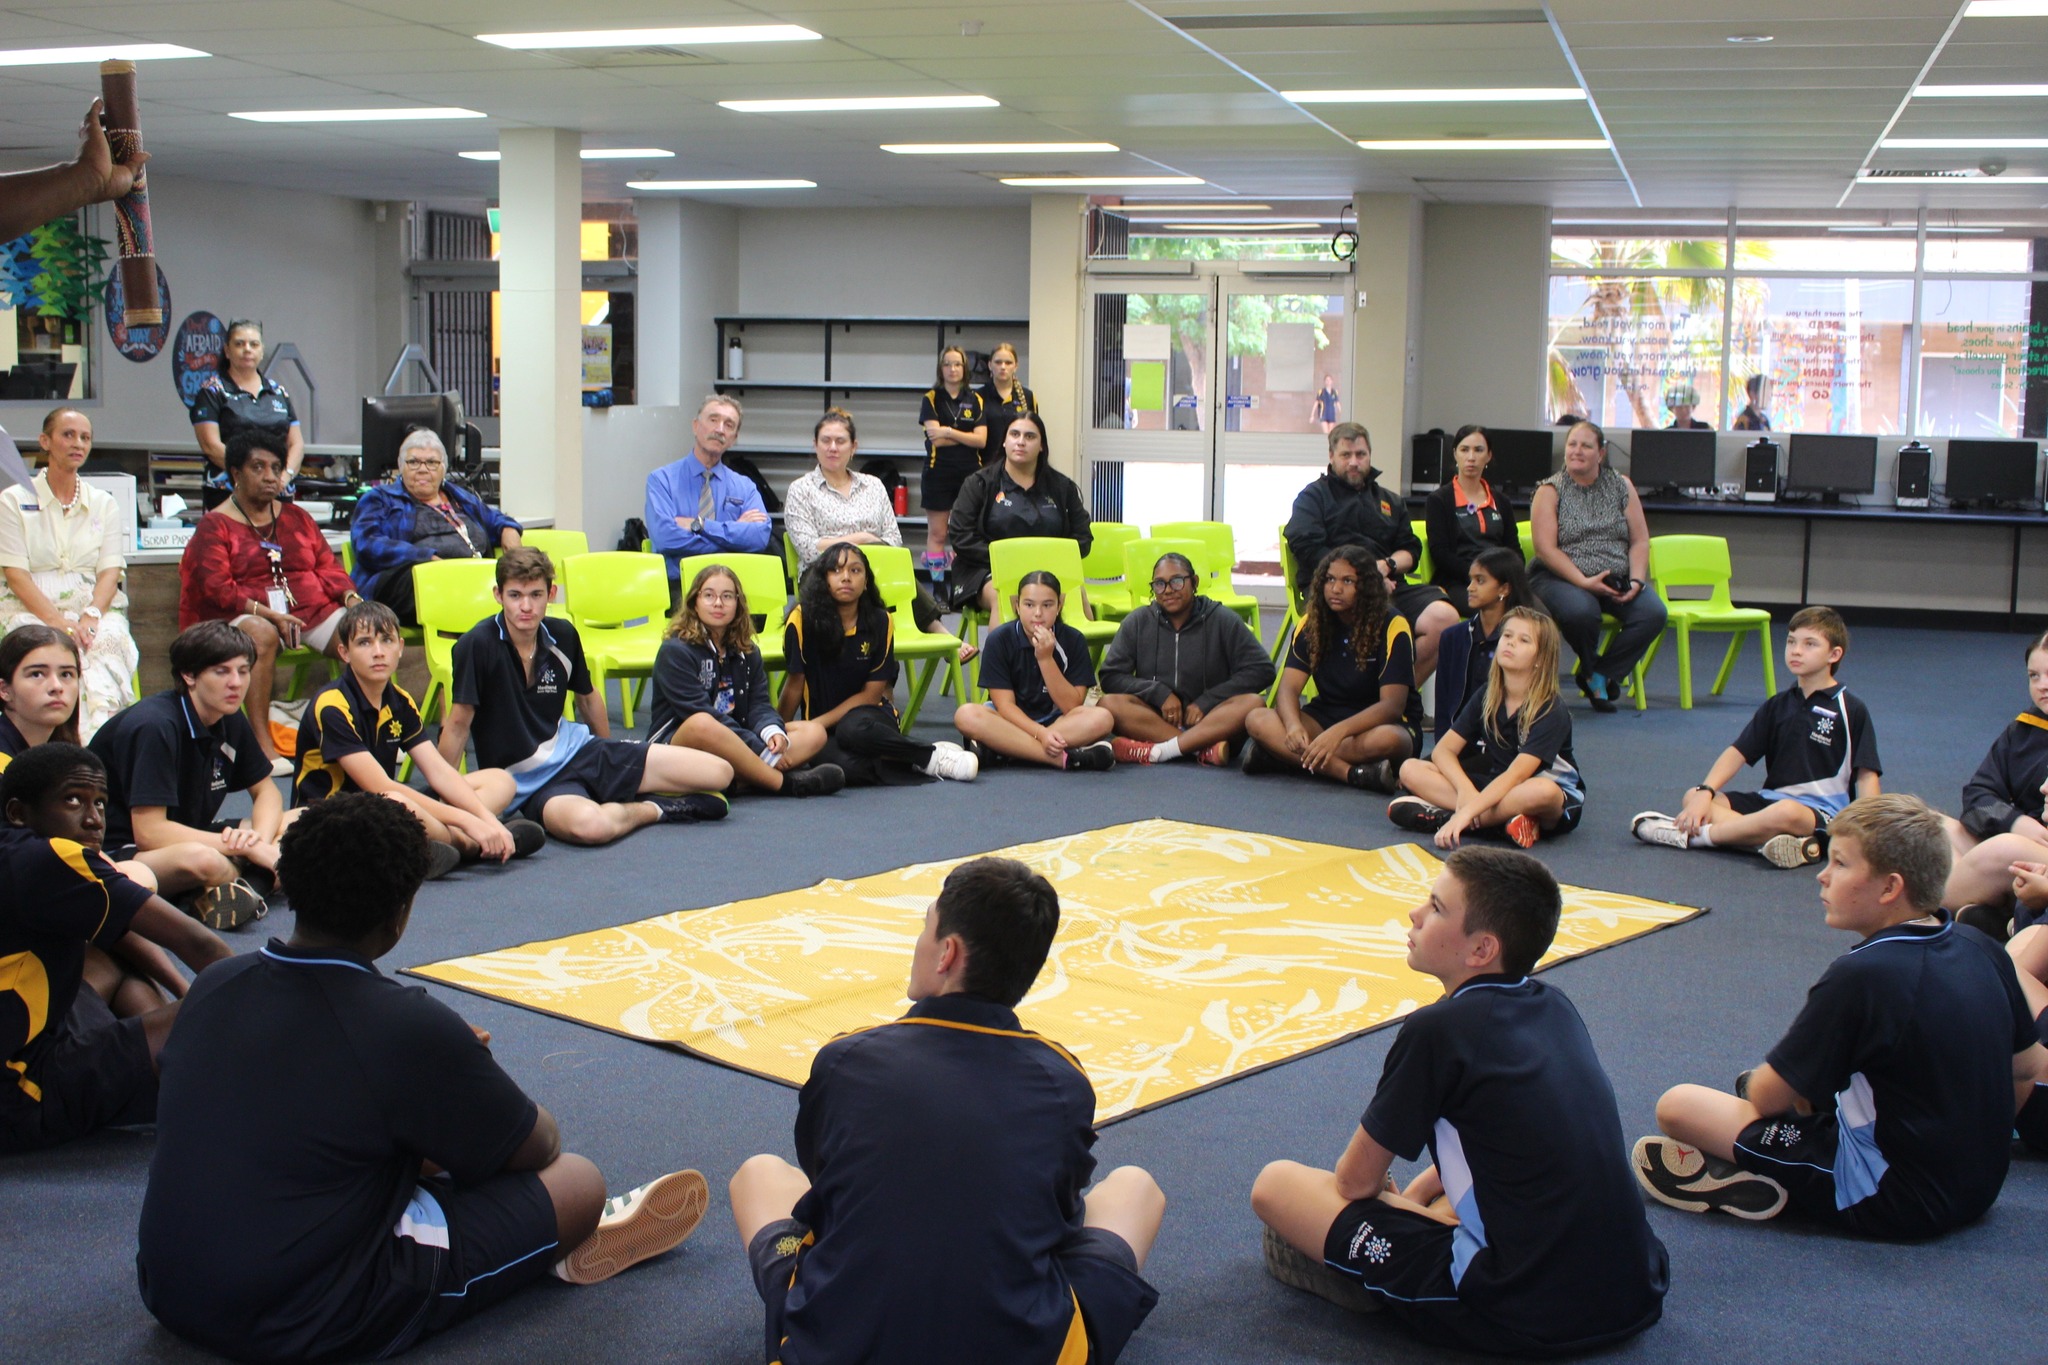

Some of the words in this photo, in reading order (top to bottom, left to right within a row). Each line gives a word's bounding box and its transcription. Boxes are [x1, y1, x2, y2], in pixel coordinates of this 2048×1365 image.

[128, 327, 150, 343] WAY
[186, 333, 221, 355] AFRAID
[143, 535, 169, 546] SCRAP
